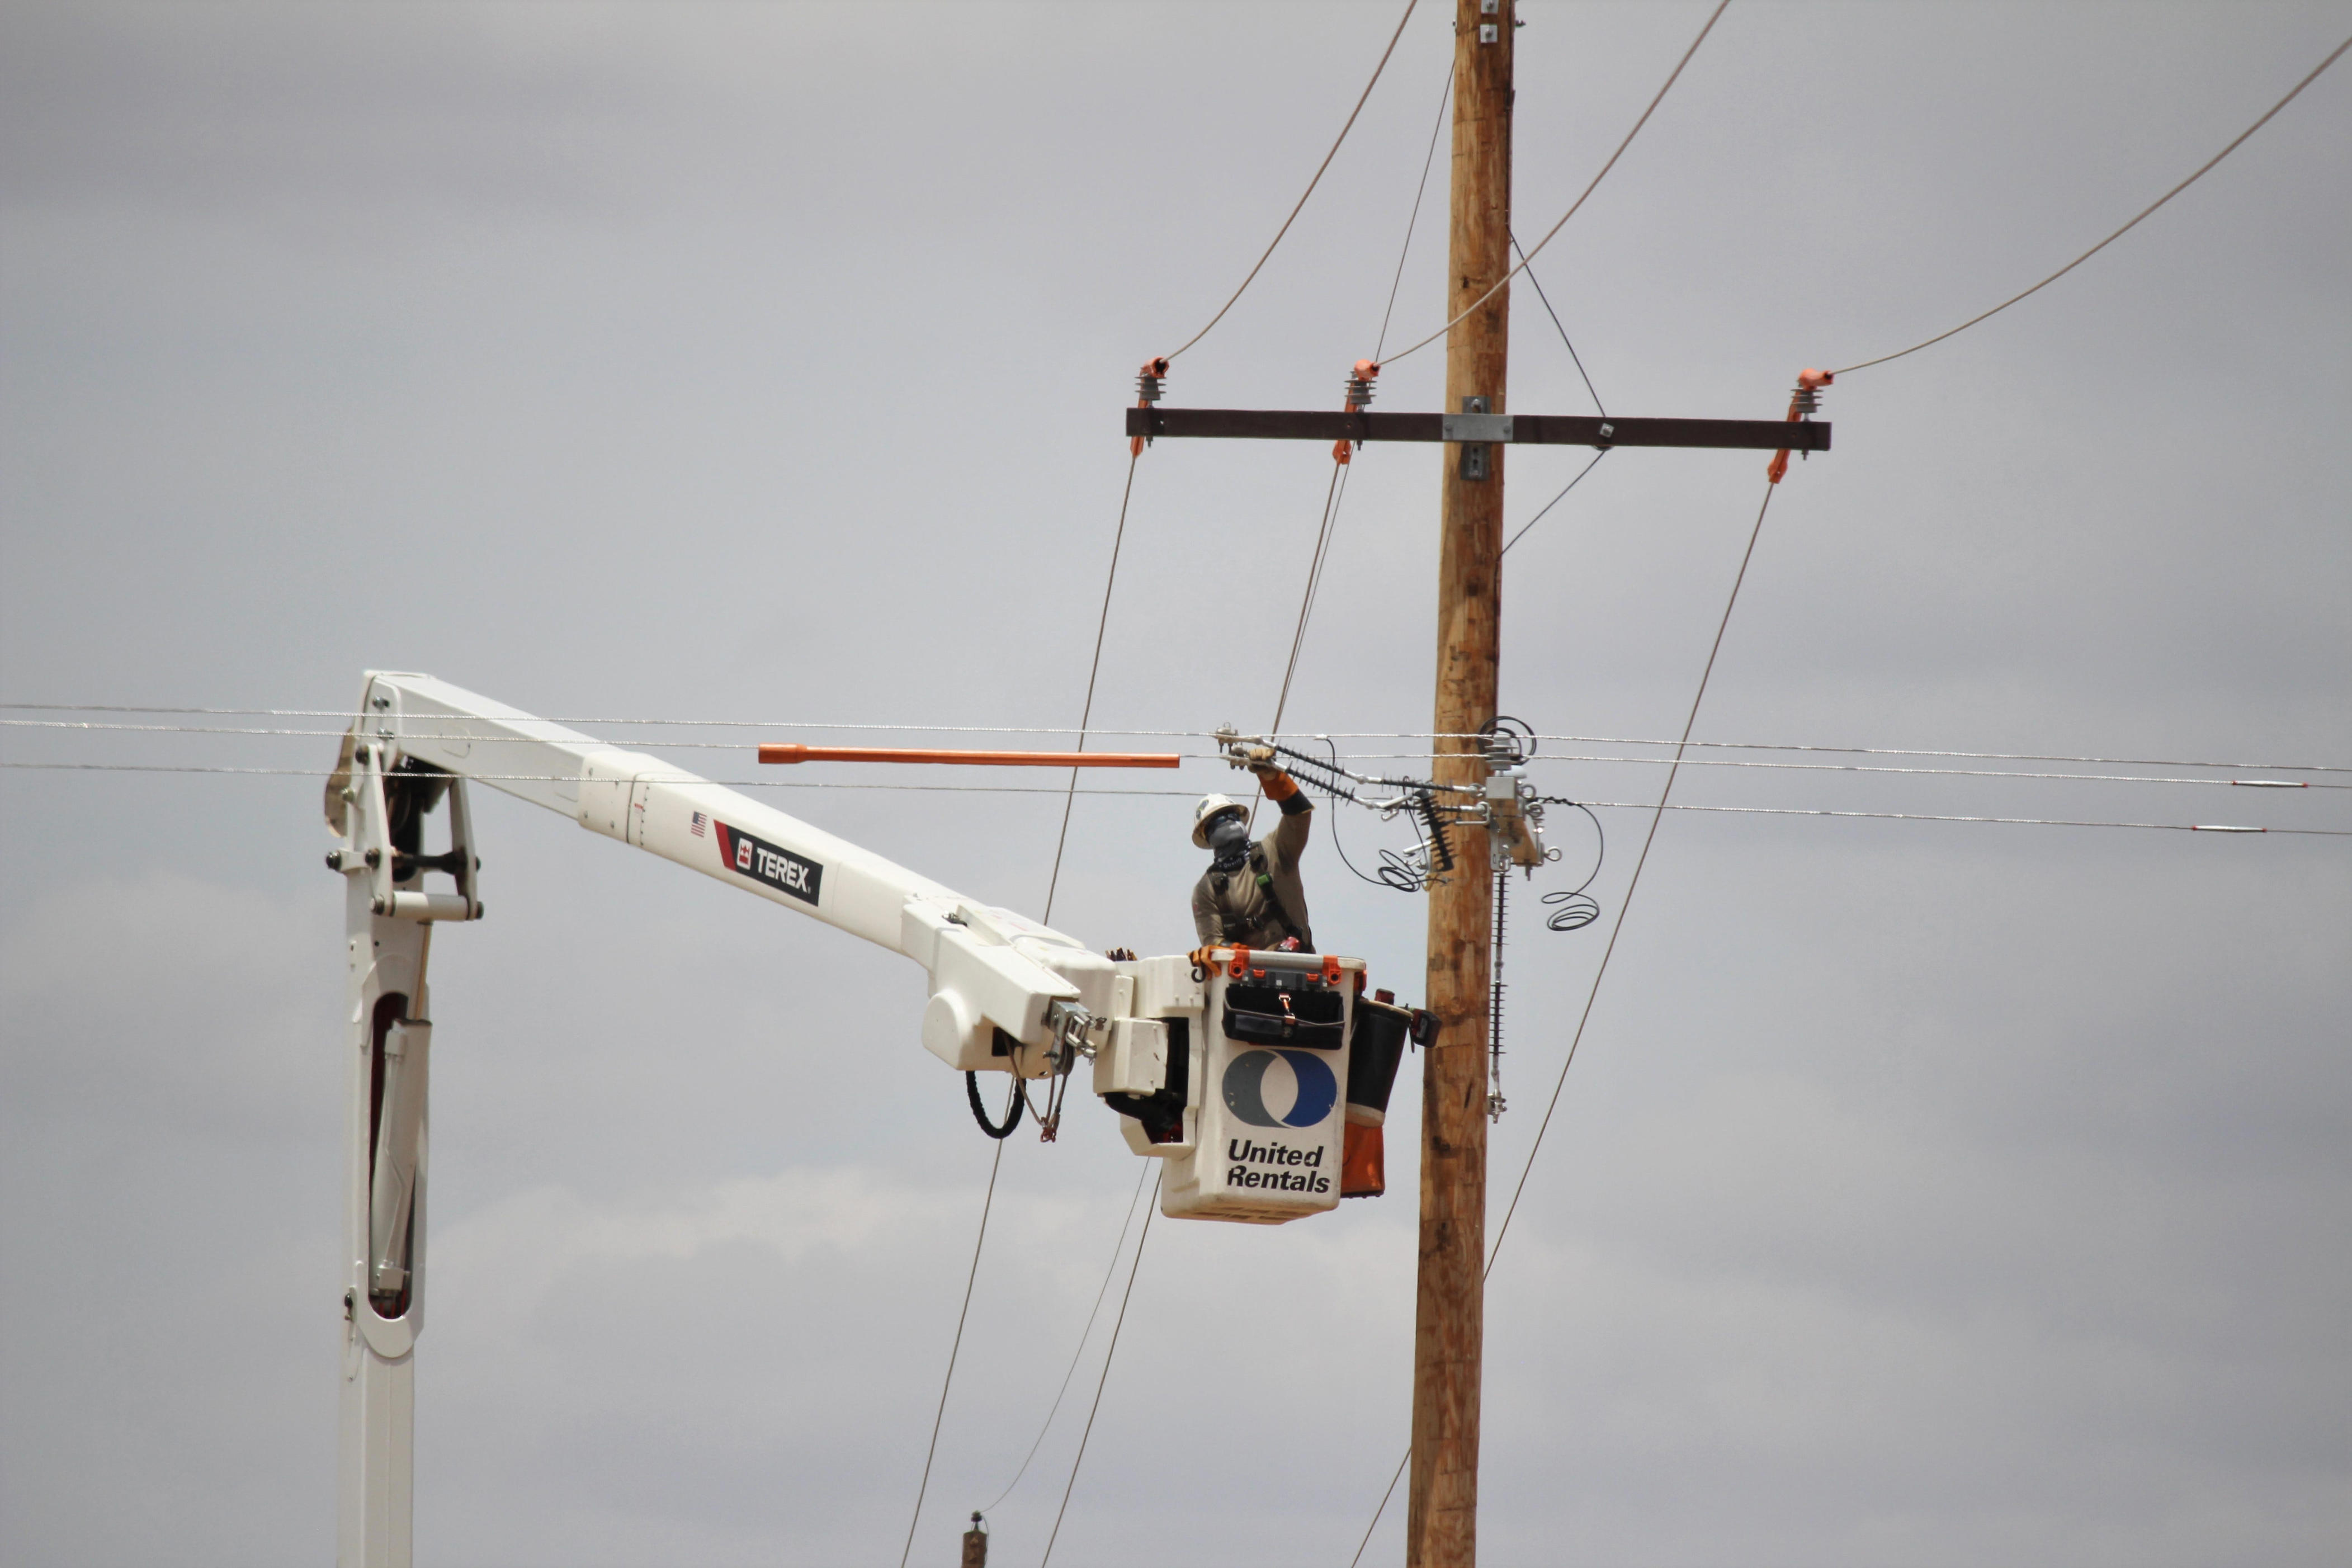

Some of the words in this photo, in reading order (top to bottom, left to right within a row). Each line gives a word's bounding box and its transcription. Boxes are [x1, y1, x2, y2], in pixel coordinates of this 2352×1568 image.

[757, 847, 809, 894] TEREX
[1229, 1139, 1324, 1168] United
[1227, 1165, 1330, 1193] Rentals
